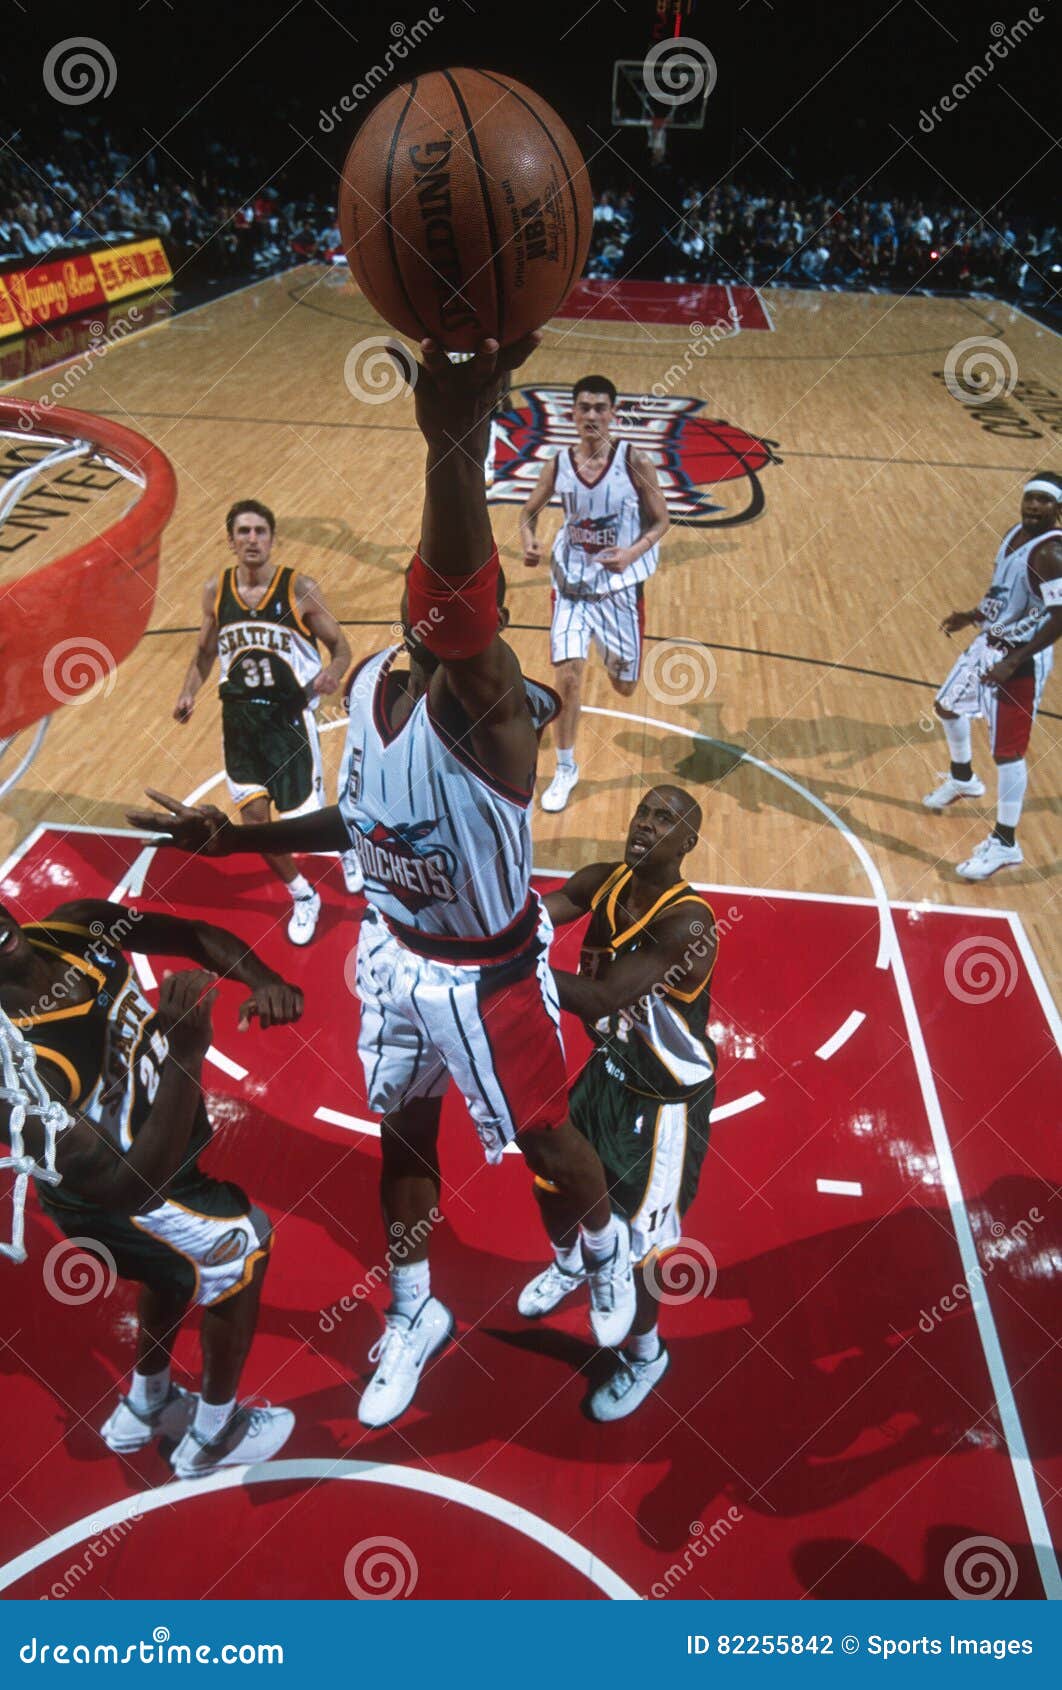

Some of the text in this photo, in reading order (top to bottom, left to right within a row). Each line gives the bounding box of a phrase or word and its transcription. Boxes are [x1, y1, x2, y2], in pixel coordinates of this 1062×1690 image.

[521, 199, 546, 260] NBA
[218, 626, 292, 655] SEATTLE
[241, 657, 276, 688] 31
[352, 825, 454, 900] ROCKETS
